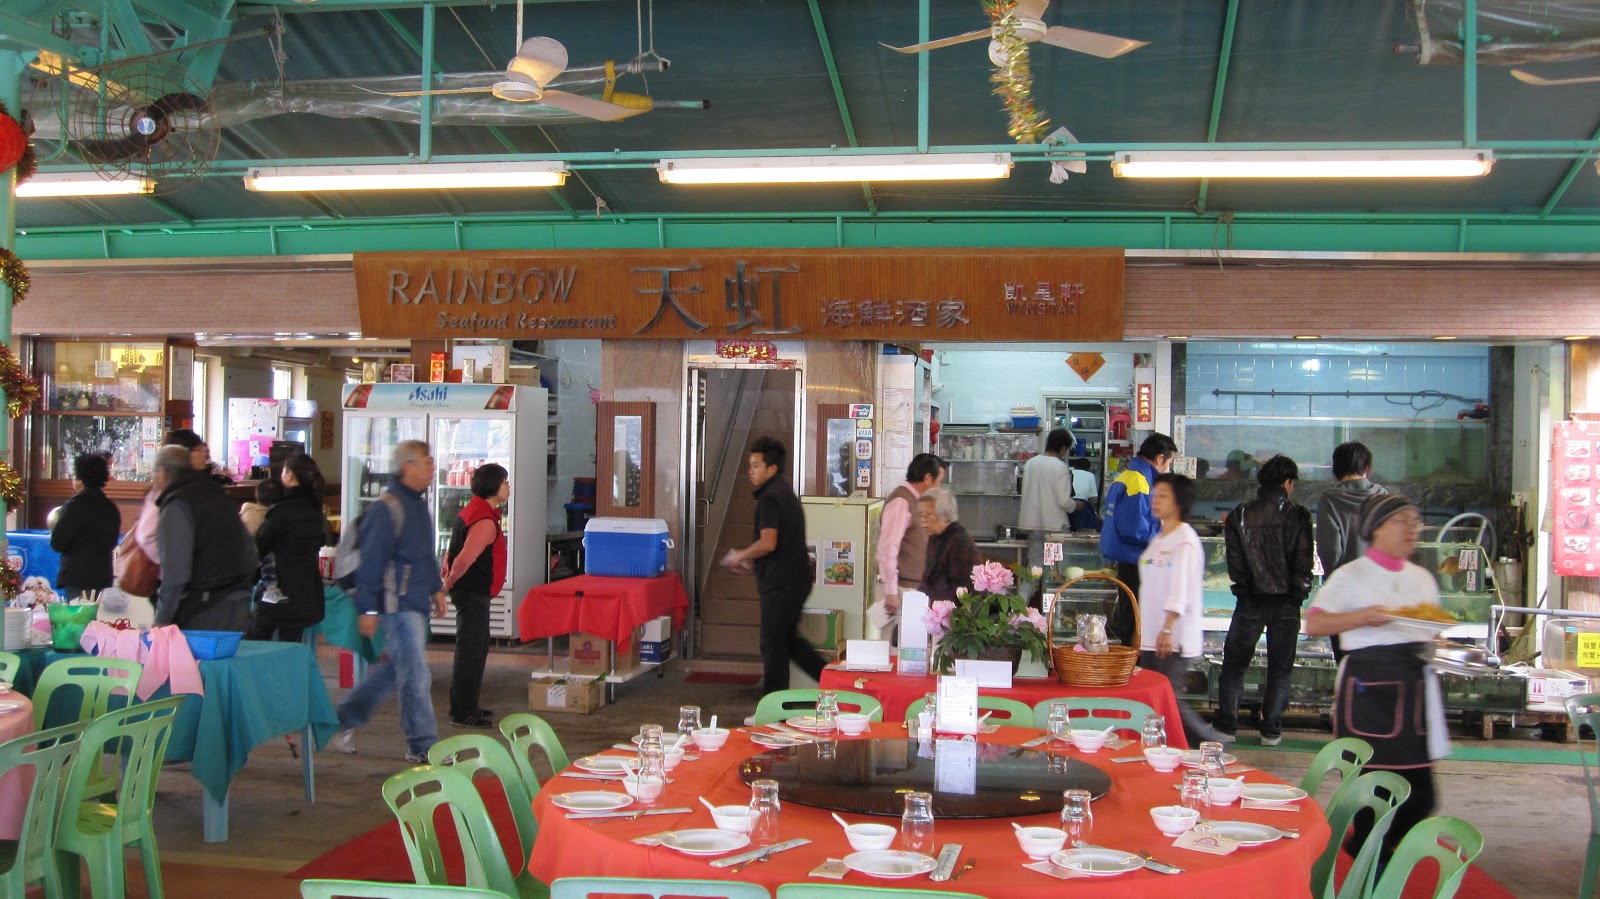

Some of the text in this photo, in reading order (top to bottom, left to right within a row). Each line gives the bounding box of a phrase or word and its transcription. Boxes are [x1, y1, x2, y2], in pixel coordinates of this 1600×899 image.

[388, 267, 577, 304] RAINBOW
[629, 260, 804, 335] 天虹
[436, 312, 618, 333] Seafood Restaurant
[819, 298, 971, 329] 海鮮酒家
[408, 386, 448, 401] Asahi
